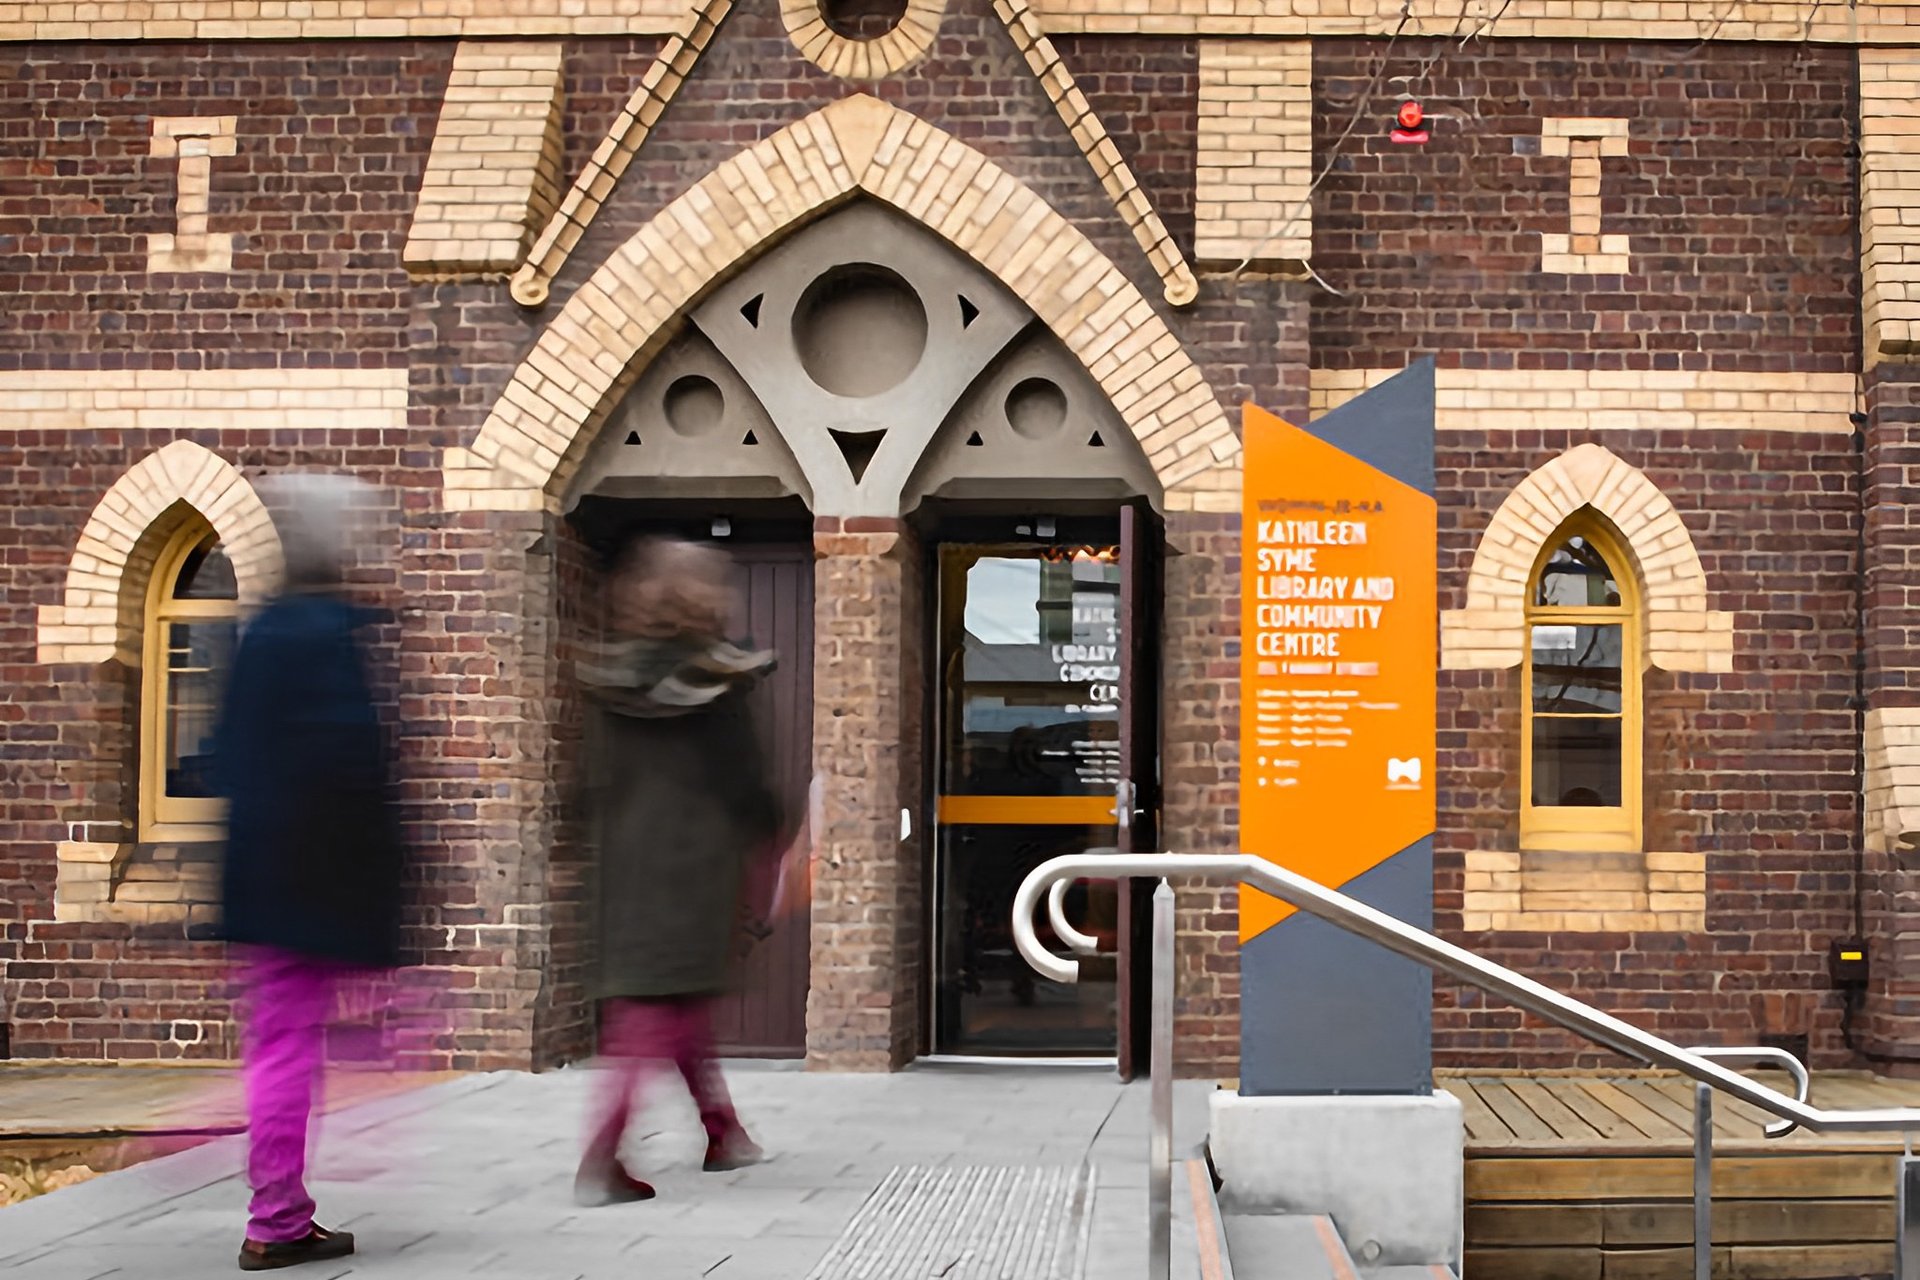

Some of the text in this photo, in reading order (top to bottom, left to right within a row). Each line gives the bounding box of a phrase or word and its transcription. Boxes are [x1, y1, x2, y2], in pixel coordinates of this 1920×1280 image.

[1257, 520, 1368, 545] KATHLEEN
[1257, 547, 1318, 572] SYME
[1256, 575, 1395, 601] LIBRARY AND
[1256, 604, 1383, 629] COMMUNITY
[1256, 632, 1340, 656] CENTRE
